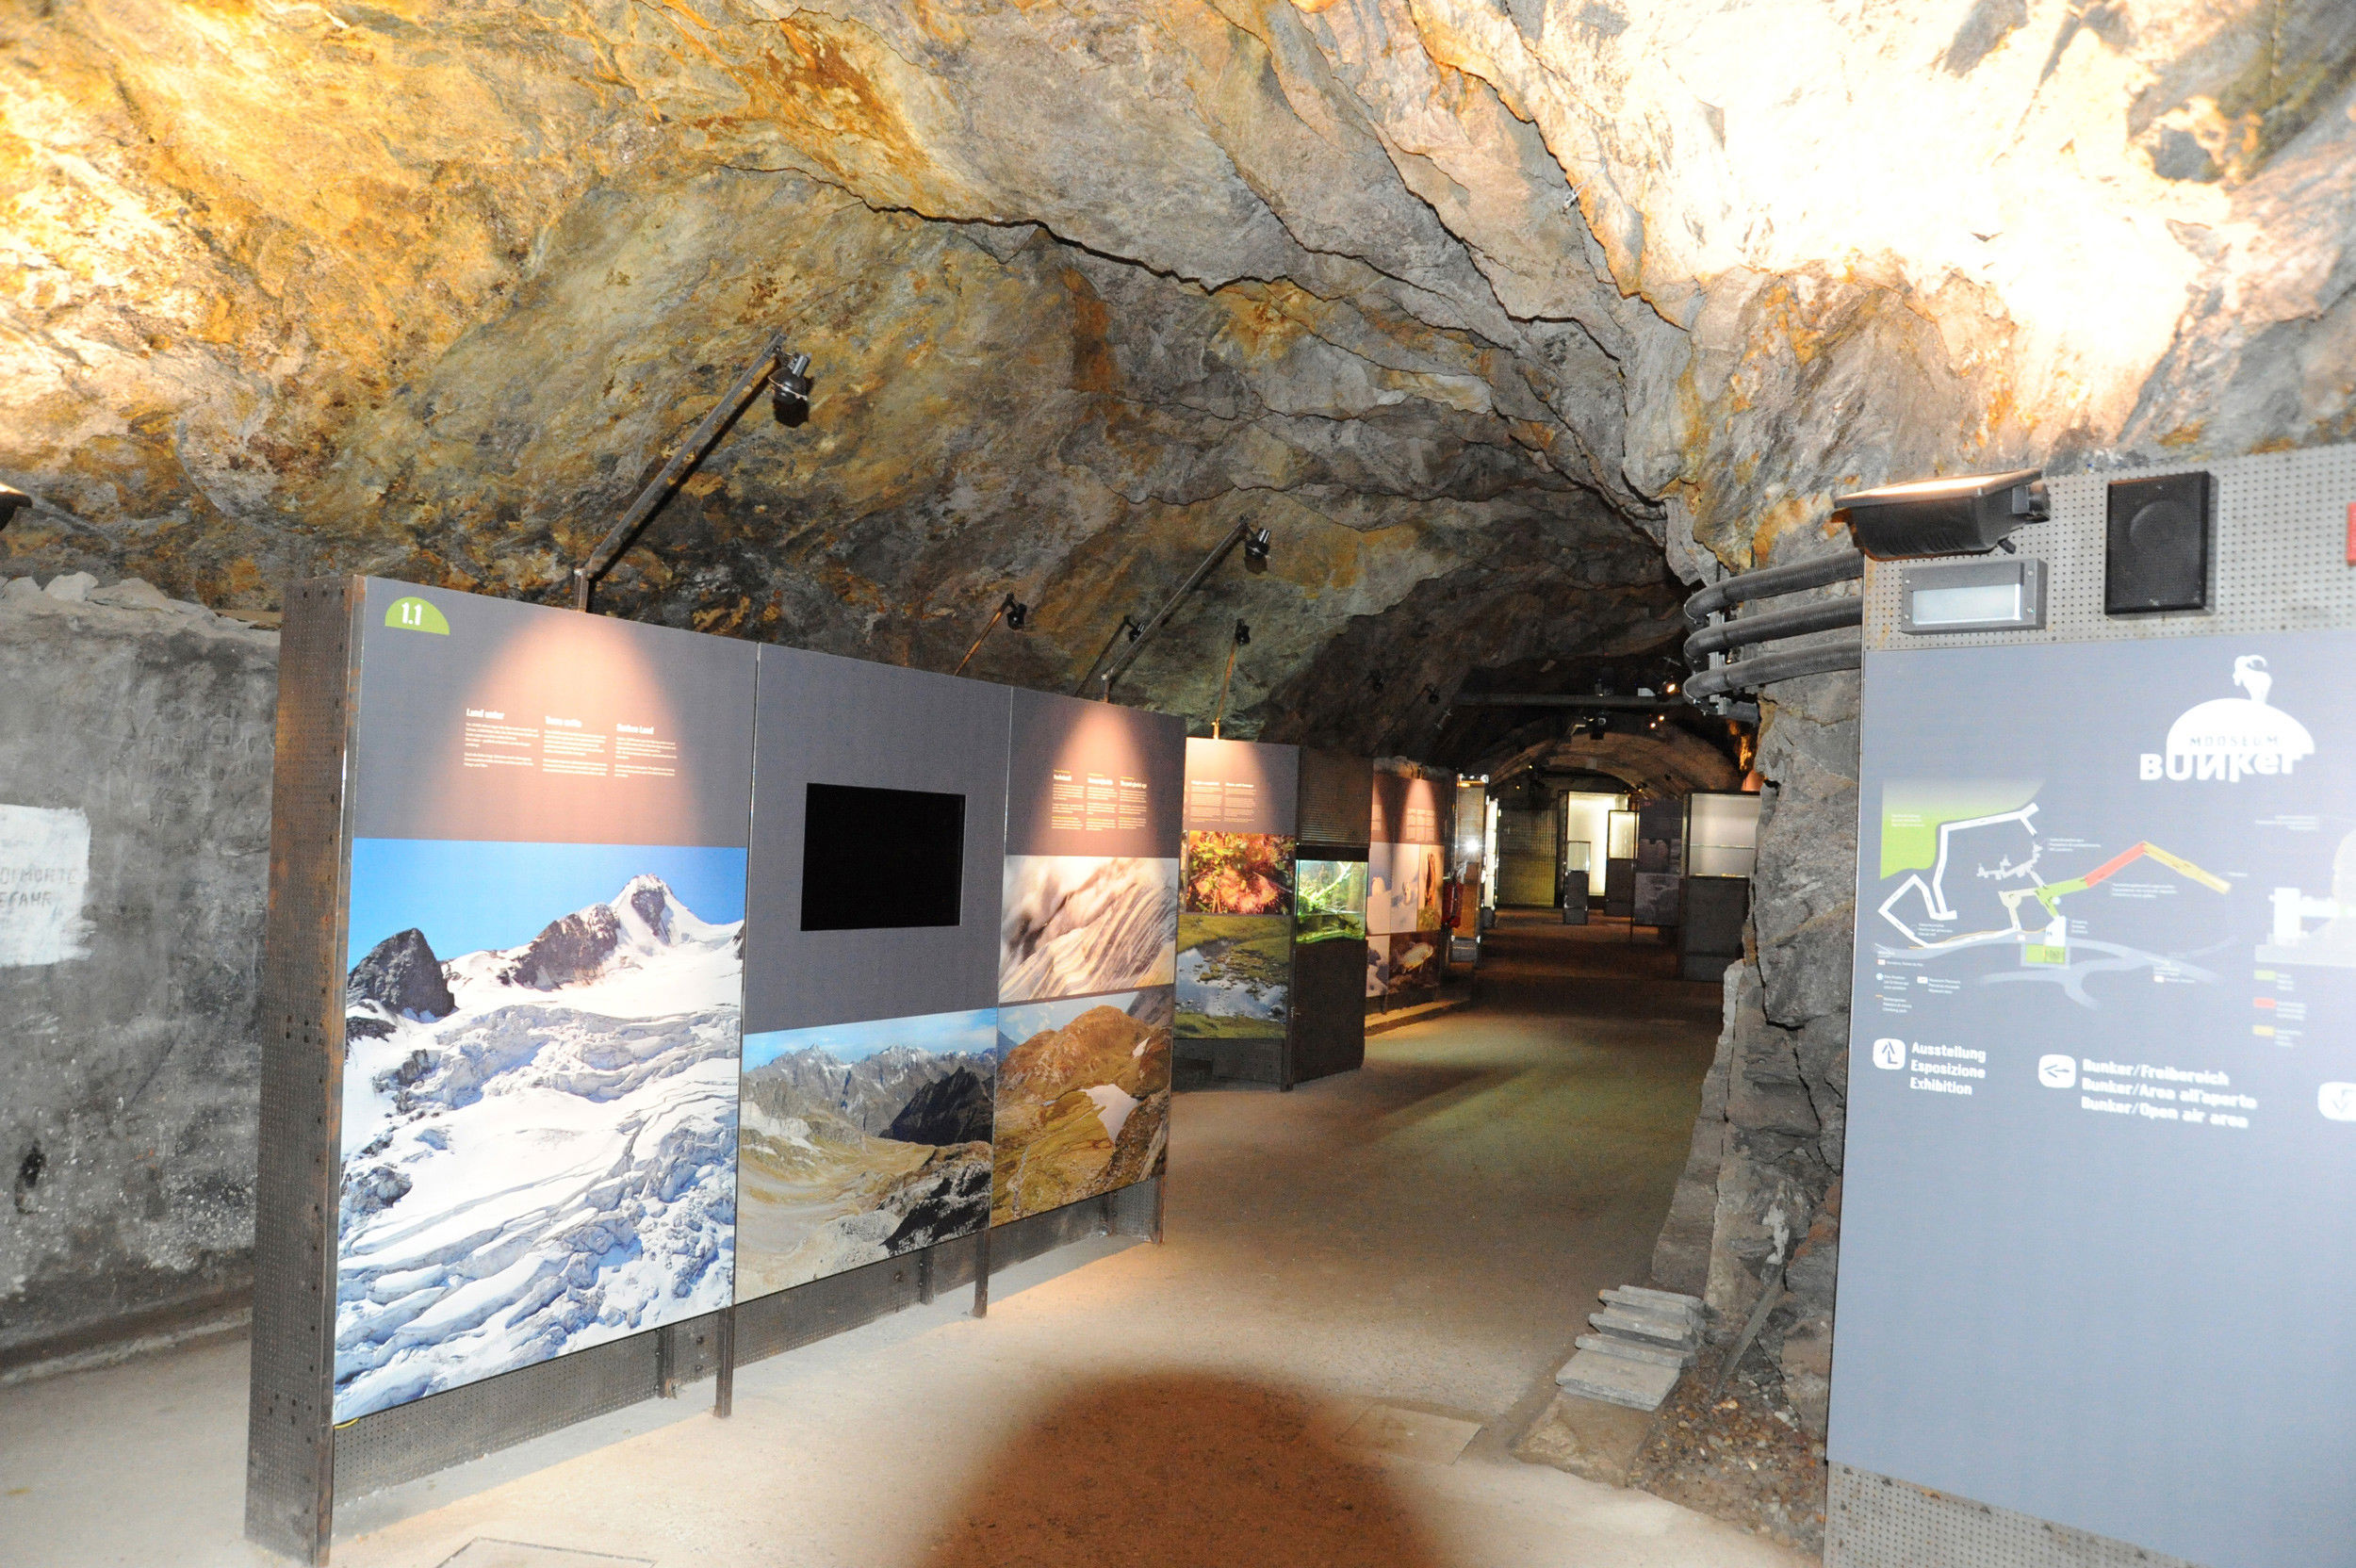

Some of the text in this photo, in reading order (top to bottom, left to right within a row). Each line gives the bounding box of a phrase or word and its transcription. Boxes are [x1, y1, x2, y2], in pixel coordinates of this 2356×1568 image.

[401, 601, 422, 627] 1.1
[1911, 1041, 1987, 1064] Ausstellung
[1910, 1058, 1987, 1079] Esposizione
[1909, 1076, 1972, 1096] Exhibition
[2182, 1108, 2206, 1123] air
